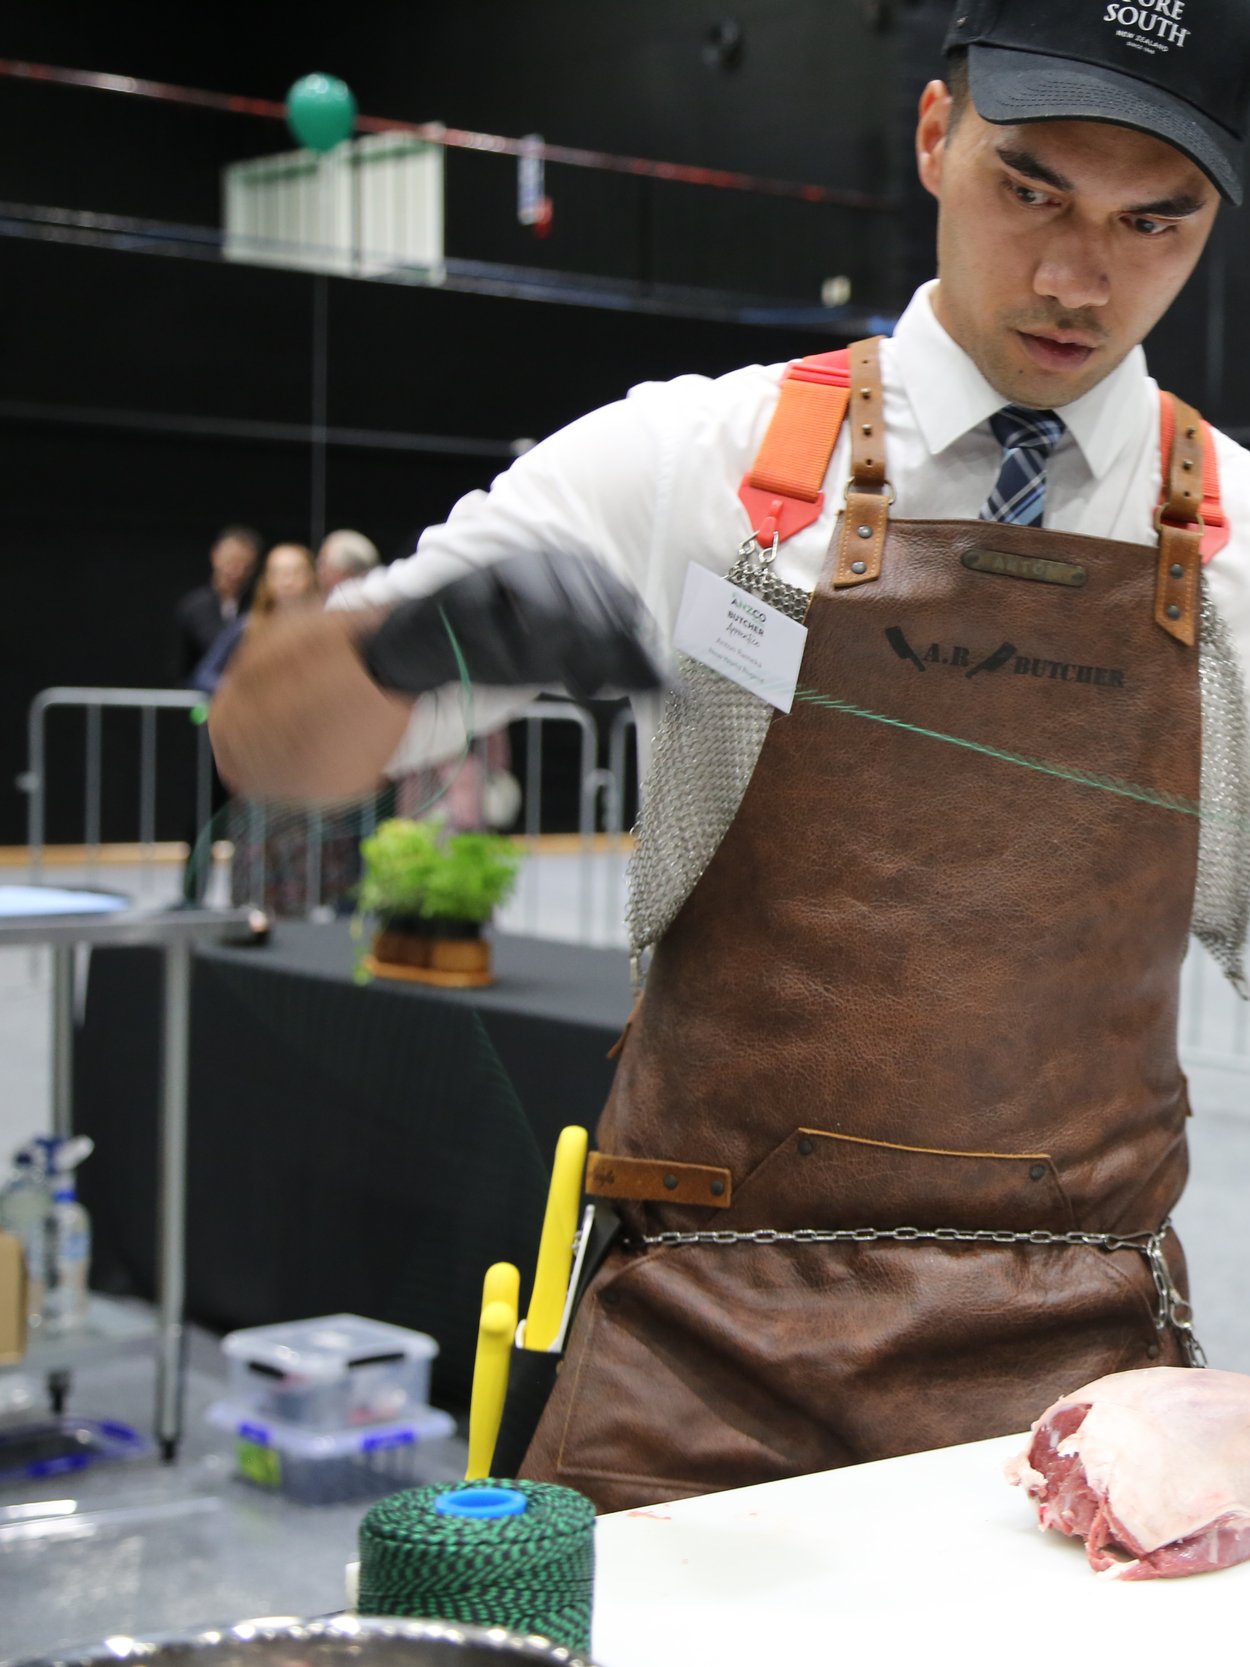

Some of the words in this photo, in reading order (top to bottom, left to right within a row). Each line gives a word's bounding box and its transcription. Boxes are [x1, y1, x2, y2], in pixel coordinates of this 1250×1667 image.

[1103, 3, 1191, 47] SOUTH
[1115, 30, 1135, 39] NEW
[1134, 34, 1169, 52] ZEALAND
[728, 610, 764, 636] BUTCHER
[731, 598, 766, 623] ANZCO
[1012, 655, 1125, 688] BUTCHER
